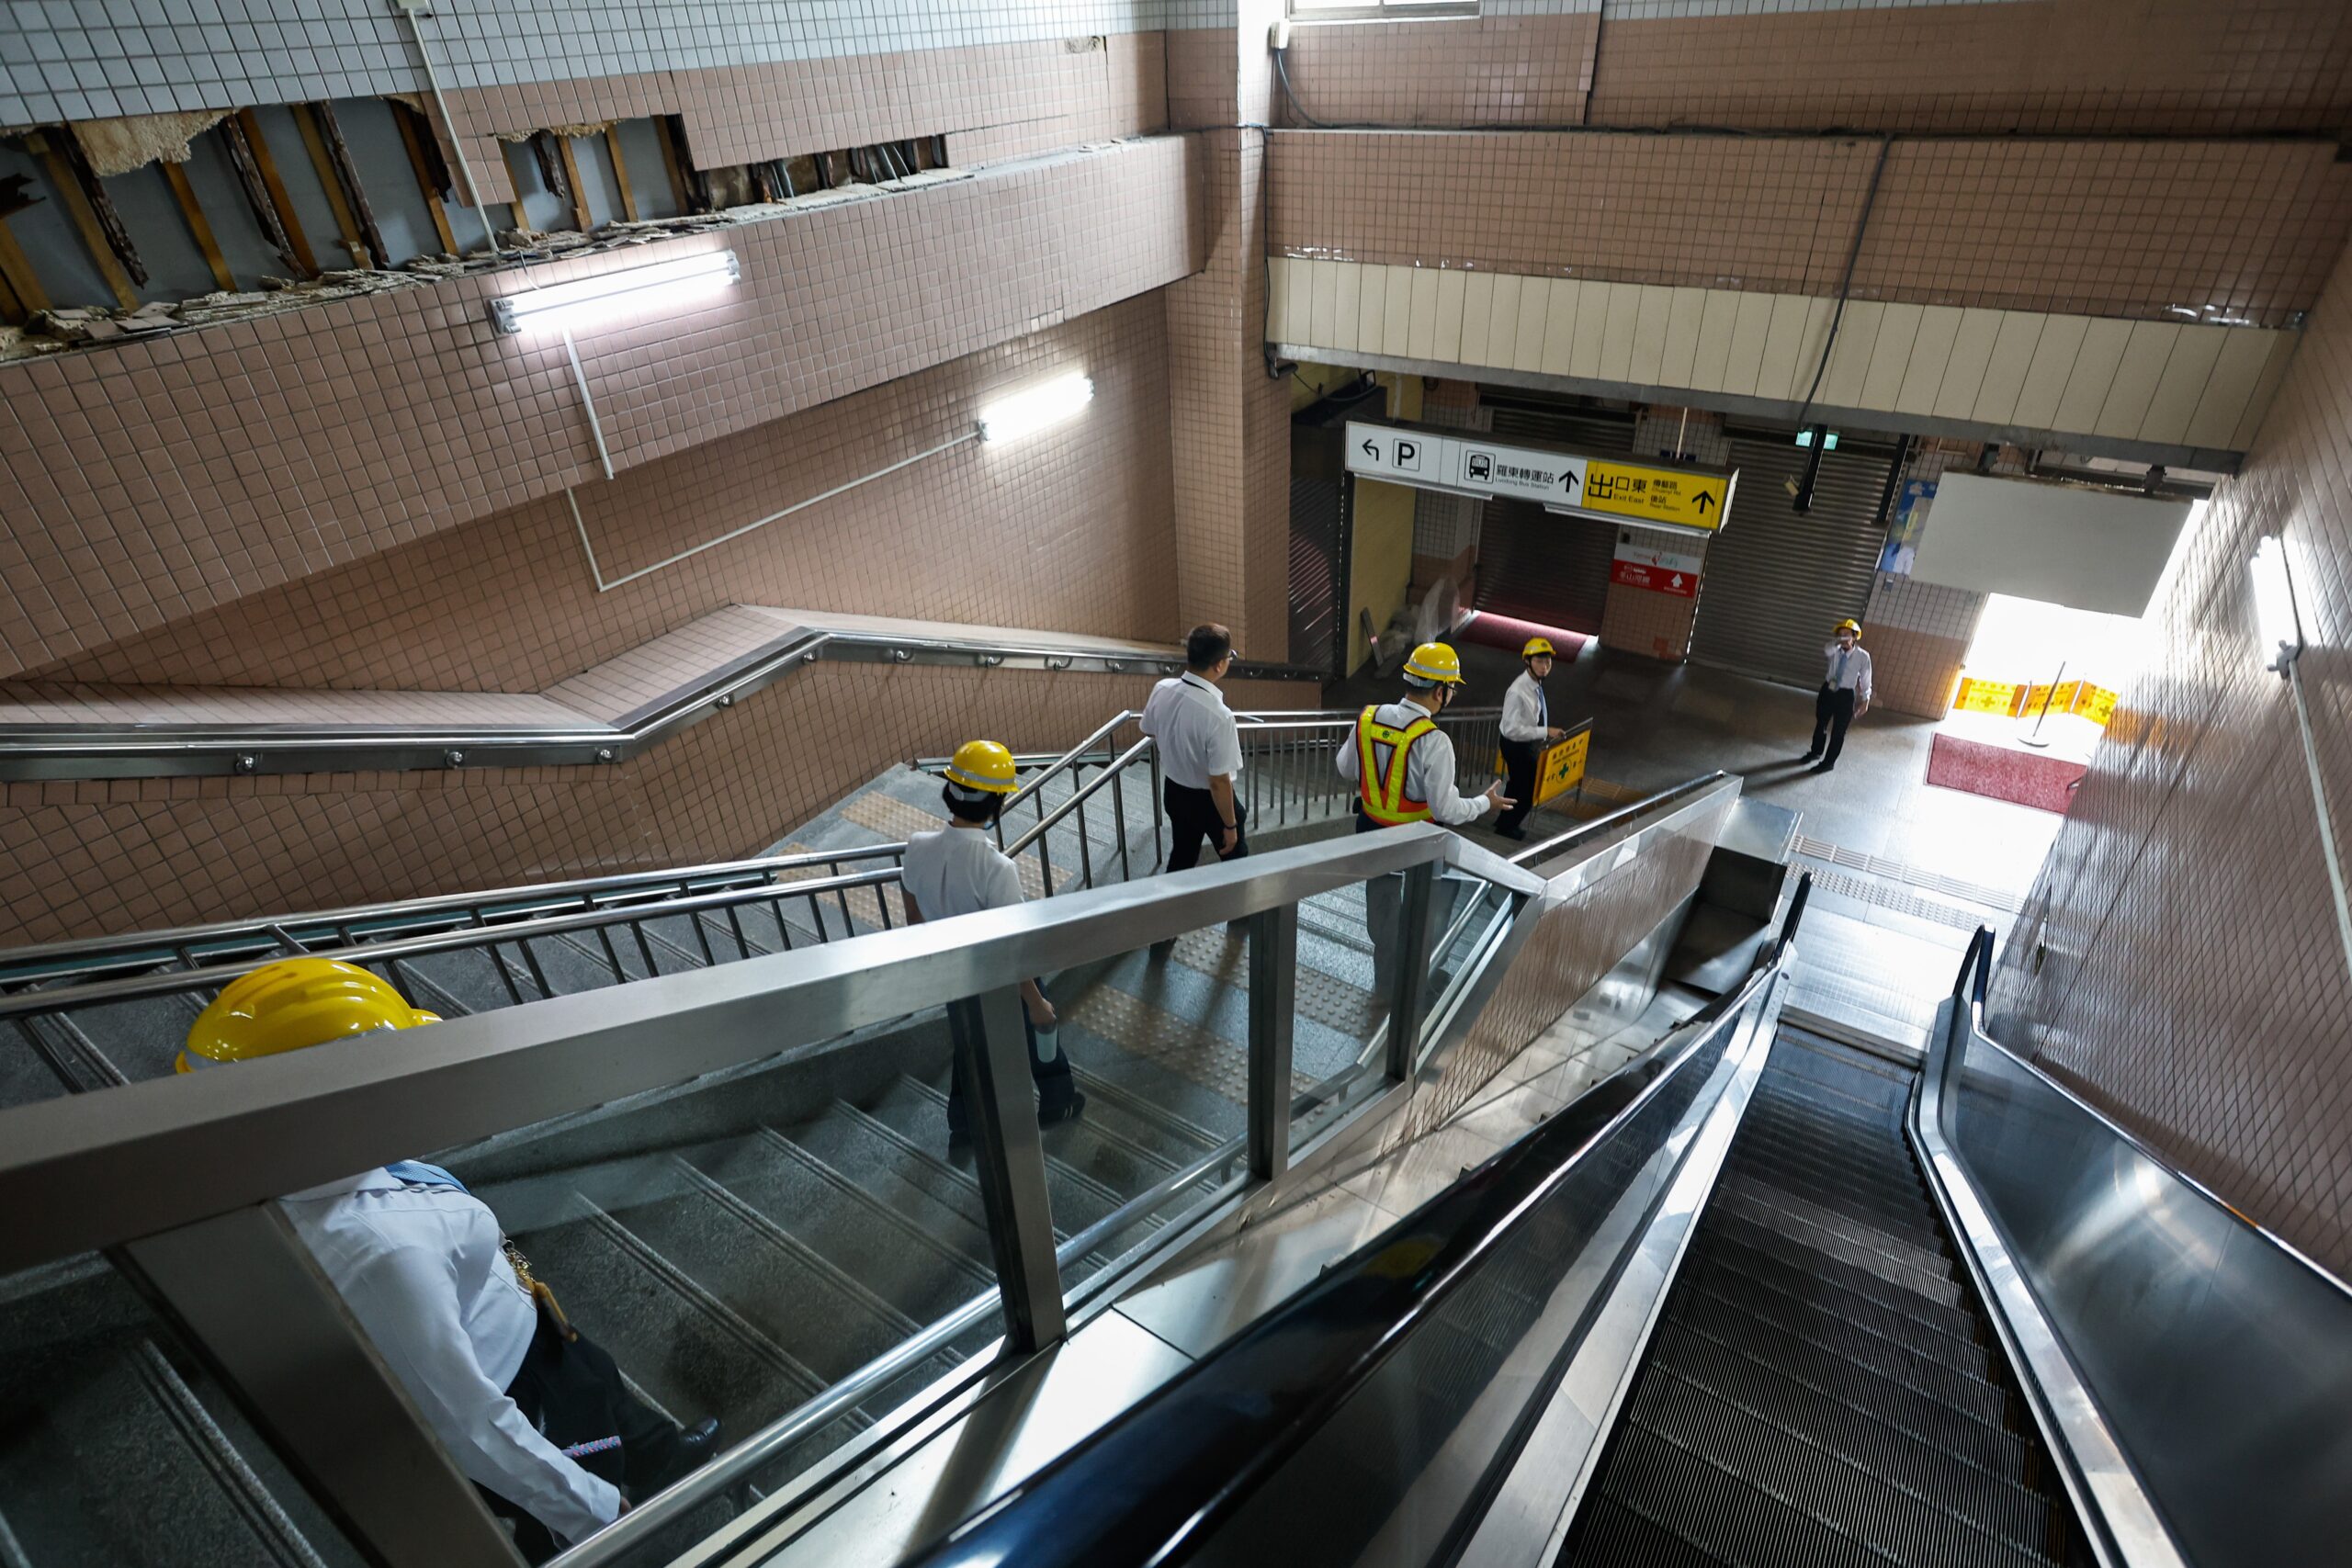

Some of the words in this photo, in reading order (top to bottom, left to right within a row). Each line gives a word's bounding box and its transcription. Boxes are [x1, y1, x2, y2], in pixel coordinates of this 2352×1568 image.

[1397, 443, 1416, 467] P
[1497, 464, 1555, 485] 羅東轉運站
[1613, 493, 1627, 502] Exit
[1629, 495, 1645, 504] East
